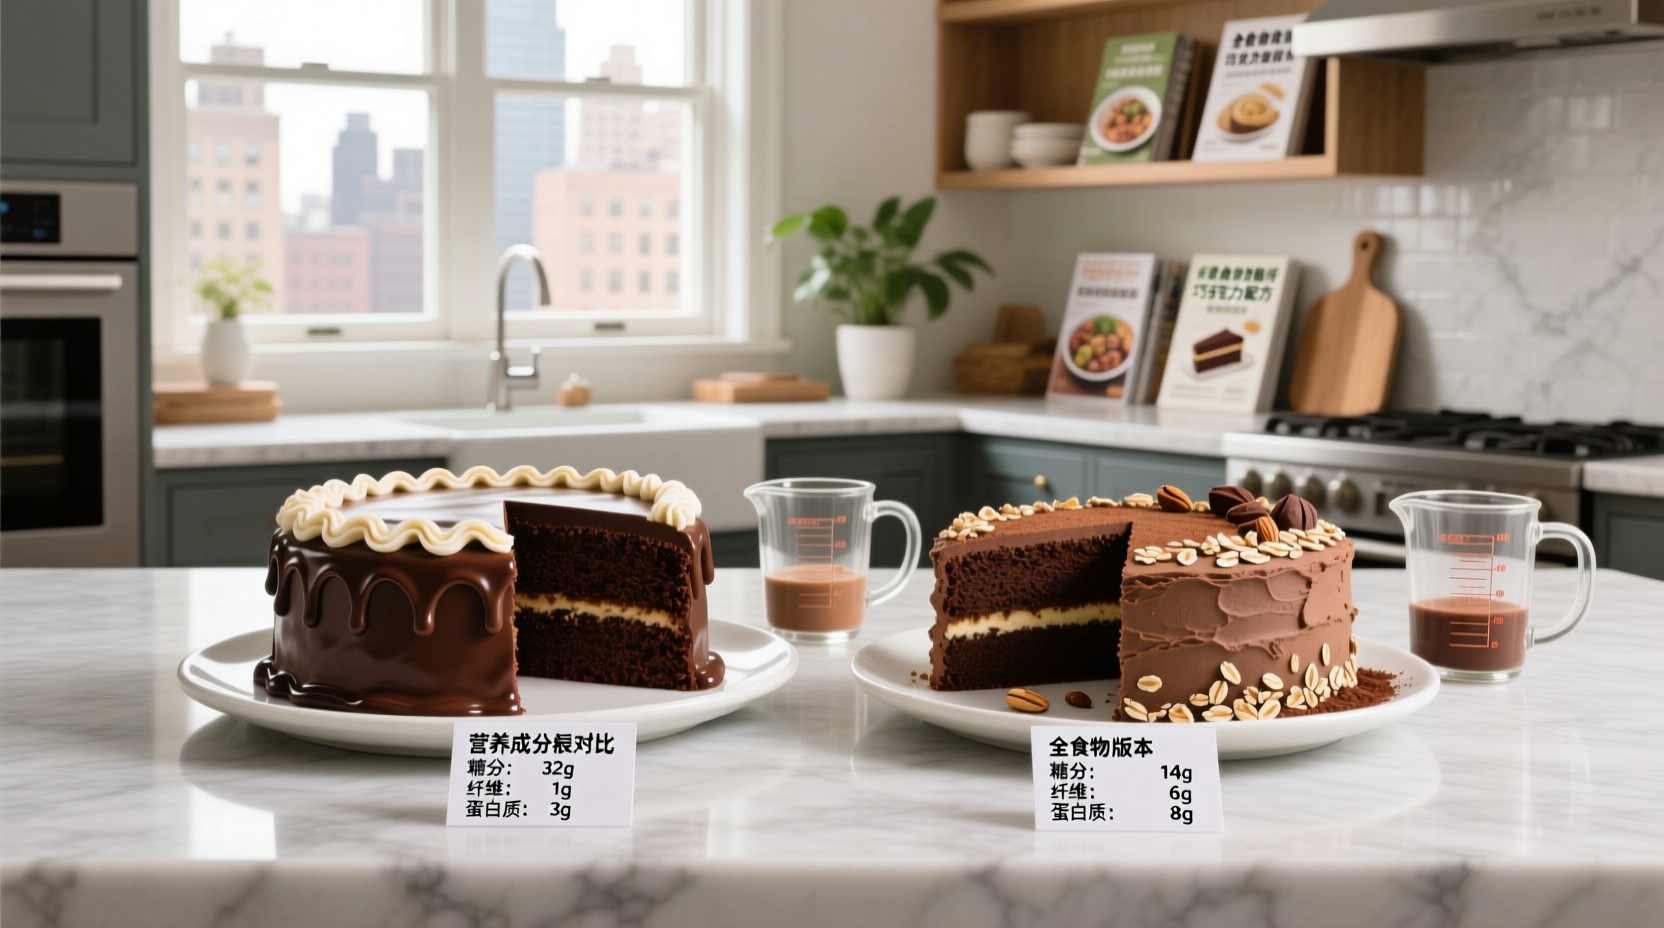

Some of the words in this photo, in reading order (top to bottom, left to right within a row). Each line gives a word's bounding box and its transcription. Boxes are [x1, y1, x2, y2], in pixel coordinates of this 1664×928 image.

[1049, 736, 1153, 758] 全食物版本
[467, 758, 512, 777] 糖分：
[542, 760, 574, 779] 32g
[1049, 760, 1094, 780] 糖分：
[1160, 764, 1192, 783] 14g
[466, 779, 511, 798] 纤维：
[552, 781, 572, 800] 1g
[1050, 782, 1095, 800] 纤维：
[1169, 785, 1192, 804] 6g
[465, 798, 528, 818] 蛋白质：
[549, 801, 571, 821] 3g
[1051, 802, 1114, 822] 蛋白质：
[1170, 805, 1193, 825] 8g
